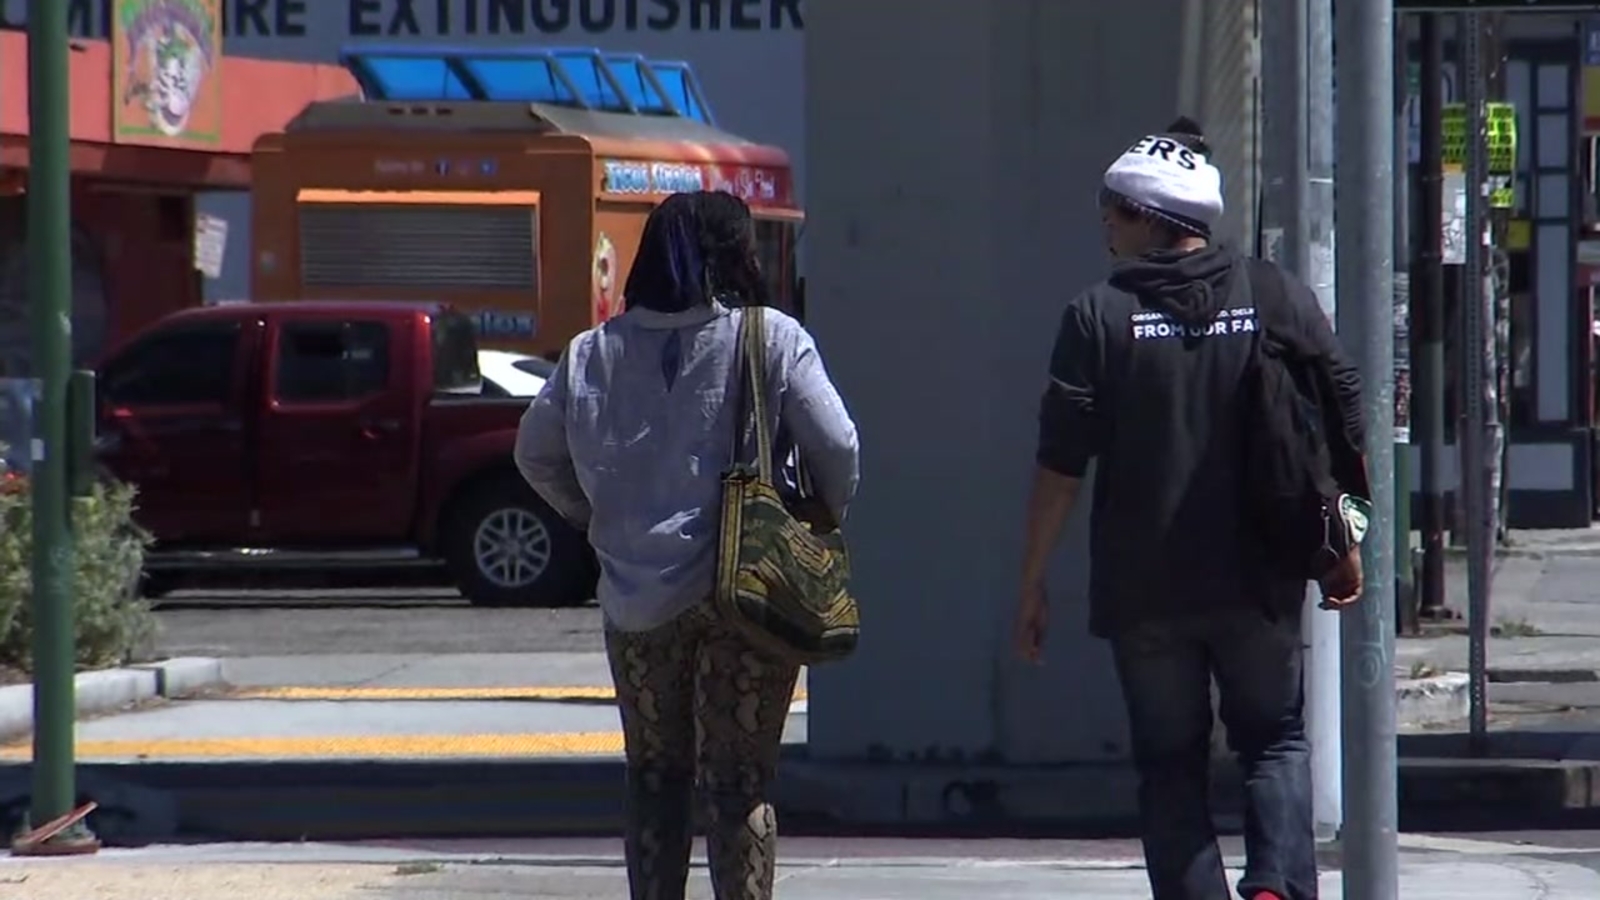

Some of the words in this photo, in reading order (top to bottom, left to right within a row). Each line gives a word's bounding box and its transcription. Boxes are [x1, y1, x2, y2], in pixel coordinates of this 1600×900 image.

[348, 0, 804, 36] EXTINGUISHER
[1129, 136, 1197, 171] ERS
[1133, 323, 1186, 340] FROM
[1189, 321, 1228, 337] OUR
